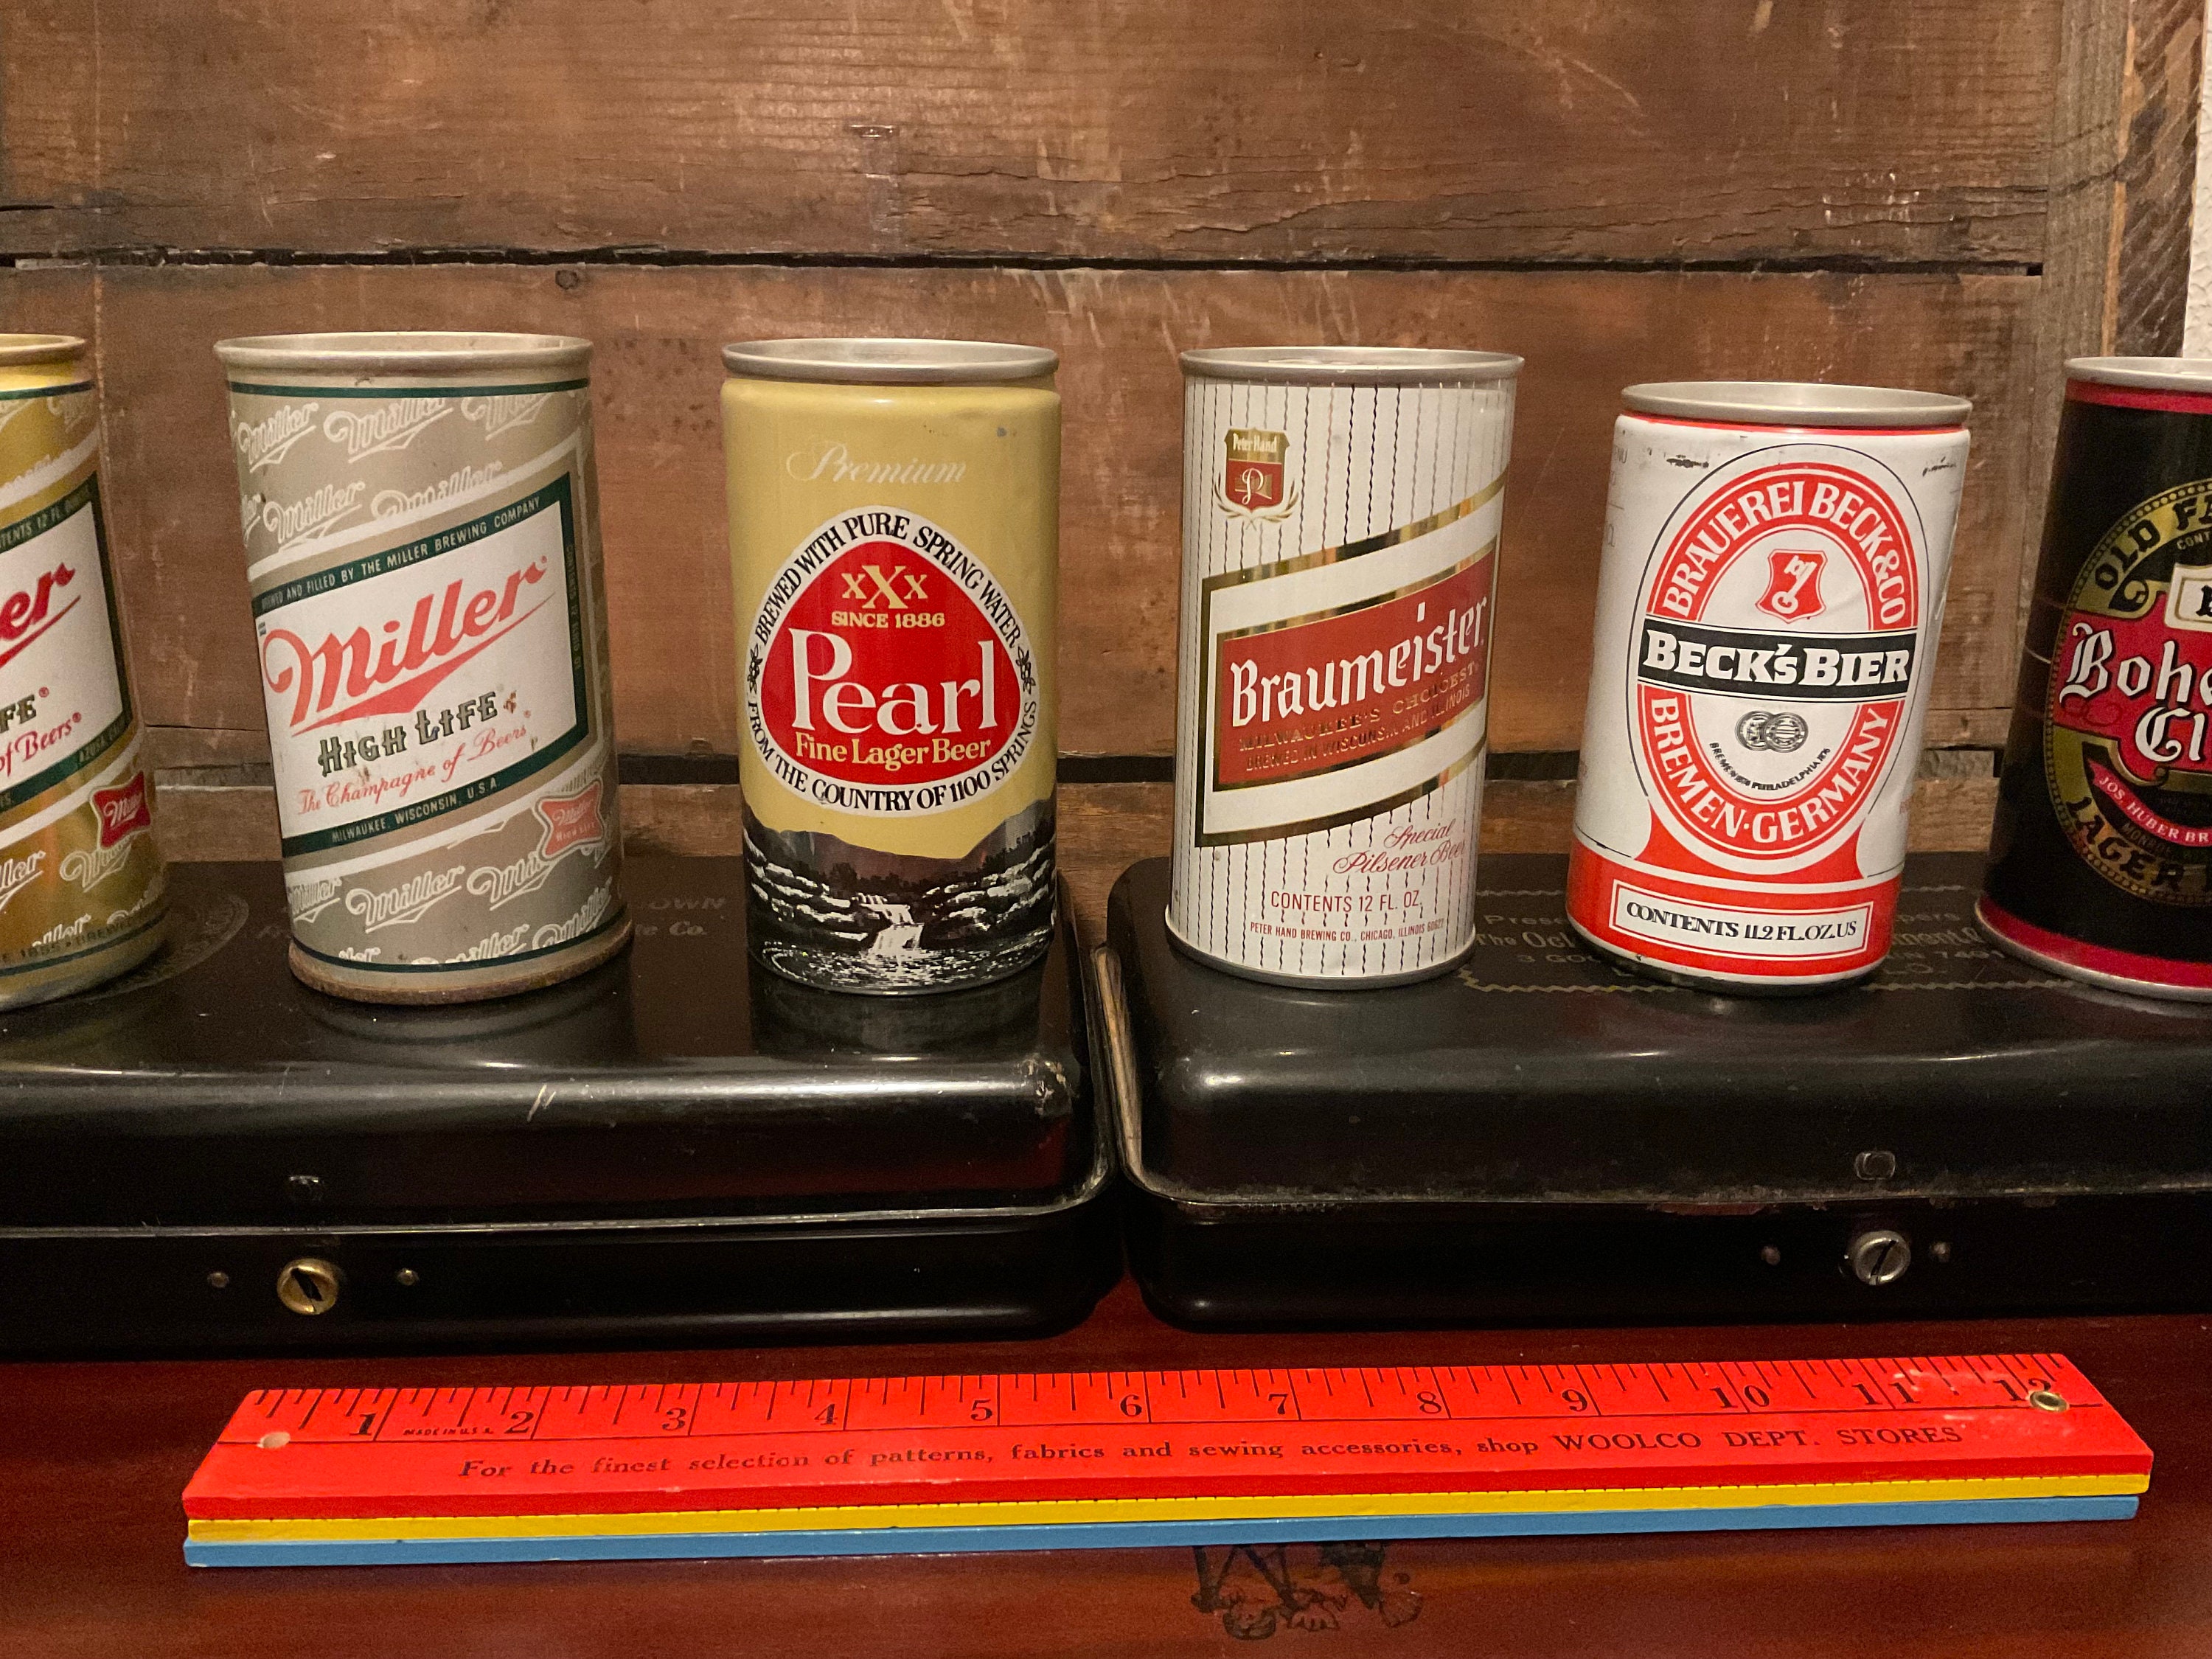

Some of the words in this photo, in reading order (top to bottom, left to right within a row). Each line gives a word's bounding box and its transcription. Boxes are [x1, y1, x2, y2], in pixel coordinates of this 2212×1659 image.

[237, 402, 319, 473] Miller
[786, 443, 966, 484] Premium
[1233, 433, 1253, 451] Peter
[1253, 435, 1277, 453] Hand
[262, 480, 366, 553] Miller
[286, 583, 303, 602] AND
[307, 574, 336, 597] FILLED
[341, 567, 355, 583] BY
[361, 560, 382, 577] THE
[387, 543, 428, 568] MILLER
[435, 521, 487, 552] BREWING
[494, 495, 540, 529] COMPANY
[1662, 480, 1804, 620] BRAUEREI
[2095, 519, 2161, 591] OLD
[755, 567, 802, 645] BREWED
[794, 526, 845, 574] WITH
[842, 512, 911, 541] PURE
[913, 526, 985, 590] SPRING
[978, 580, 1022, 649] WATER
[831, 612, 888, 627] SINCE
[894, 611, 946, 627] 1886
[263, 562, 556, 737] Miller
[1230, 594, 1487, 728] Braumeister
[1798, 647, 1910, 686] BIER
[788, 627, 998, 735] Pearl
[1393, 661, 1475, 714] CHOICEST
[318, 726, 407, 777] HIGH
[415, 691, 498, 745] LIFE
[747, 700, 774, 764] FROM
[774, 754, 809, 793] THE
[812, 778, 914, 812] COUNTRY
[916, 784, 948, 810] OF
[949, 769, 992, 801] 1100
[991, 700, 1037, 782] SPRINGS
[794, 731, 848, 764] Fine
[851, 739, 929, 771] Lager
[931, 737, 992, 764] Beer
[1246, 749, 1299, 771] BREWED
[1402, 714, 1428, 733] AND
[298, 788, 321, 815] The
[326, 765, 436, 804] Champagne
[442, 742, 466, 783] of
[467, 724, 527, 762] Beers
[1383, 818, 1456, 849] Special
[2098, 776, 2126, 804] JOS.
[2127, 801, 2180, 839] HUBER
[1333, 849, 1428, 874] Pilsener
[1430, 839, 1466, 866] Beer
[345, 865, 466, 933] Miller
[1270, 890, 1352, 914] CONTENTS
[1358, 895, 1373, 912] 12
[1380, 894, 1398, 911] FL.
[1403, 889, 1423, 908] OZ.
[1626, 901, 1739, 939] CONTENTS
[1251, 922, 1273, 936] PETER
[1276, 925, 1297, 939] HAND
[1301, 928, 1337, 942] BREWING
[1398, 924, 1425, 938] ILLINOIS
[349, 1413, 378, 1436] 1
[504, 1411, 535, 1435] 2
[661, 1408, 686, 1430] 3
[813, 1402, 838, 1426] 4
[970, 1399, 993, 1422] 5
[1119, 1394, 1143, 1417] 6
[1268, 1393, 1290, 1415] 7
[1416, 1391, 1443, 1415] 8
[1561, 1389, 1589, 1413] 9
[1709, 1385, 1771, 1410] 10
[1852, 1382, 1921, 1407] 11
[457, 1459, 514, 1477] For
[529, 1459, 575, 1475] the
[591, 1457, 672, 1474] finest
[688, 1452, 809, 1471] selection
[824, 1449, 855, 1466] of
[869, 1447, 994, 1467] patterns,
[1012, 1443, 1105, 1460] fabrics
[1122, 1441, 1173, 1458] and
[1189, 1440, 1284, 1458] sewing
[1301, 1438, 1463, 1456] accessories,
[1476, 1437, 1539, 1455] shop
[1554, 1433, 1702, 1452] WOOLCO
[1725, 1430, 1820, 1447] DEPT.
[1840, 1426, 1964, 1445] STORES
